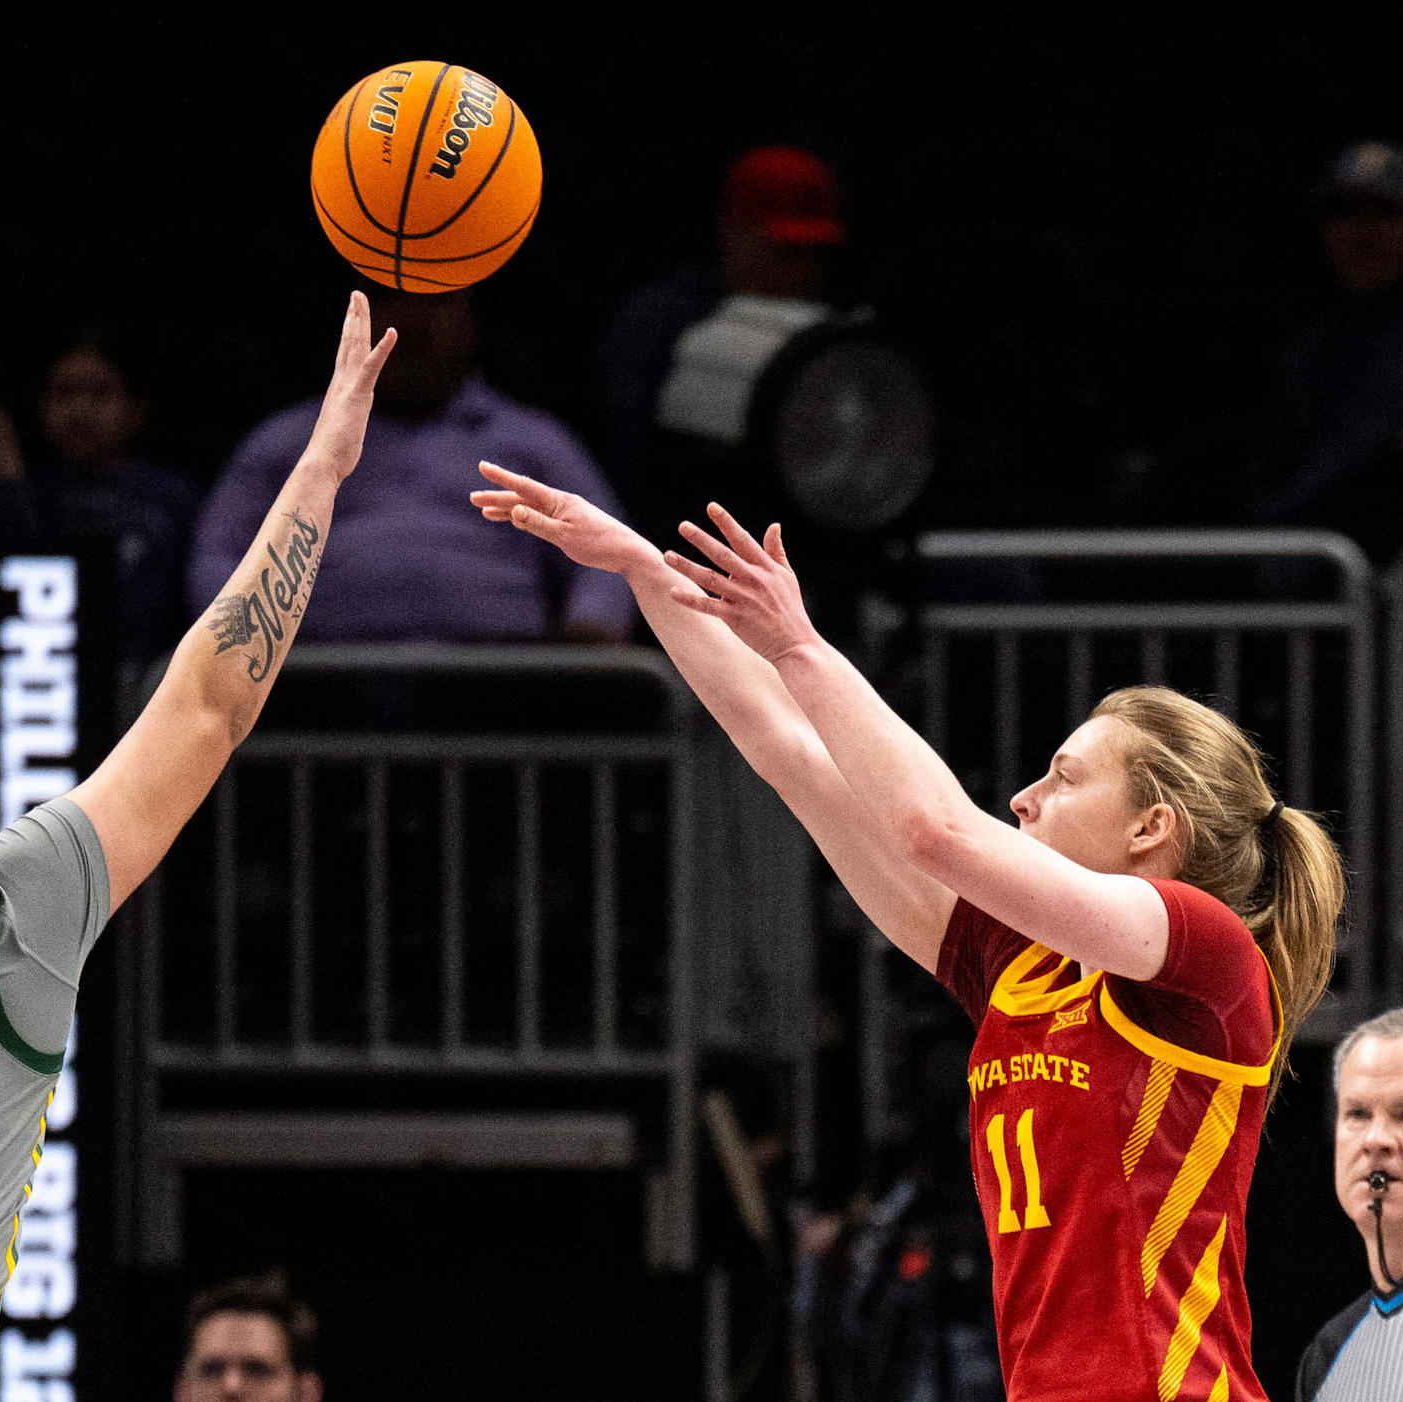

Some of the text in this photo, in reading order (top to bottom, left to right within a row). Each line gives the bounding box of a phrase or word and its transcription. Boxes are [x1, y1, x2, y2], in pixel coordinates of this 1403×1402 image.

[368, 69, 414, 135] EVO
[428, 71, 498, 180] Wilson
[1010, 1053, 1090, 1091] STATE
[986, 1108, 1052, 1235] 11
